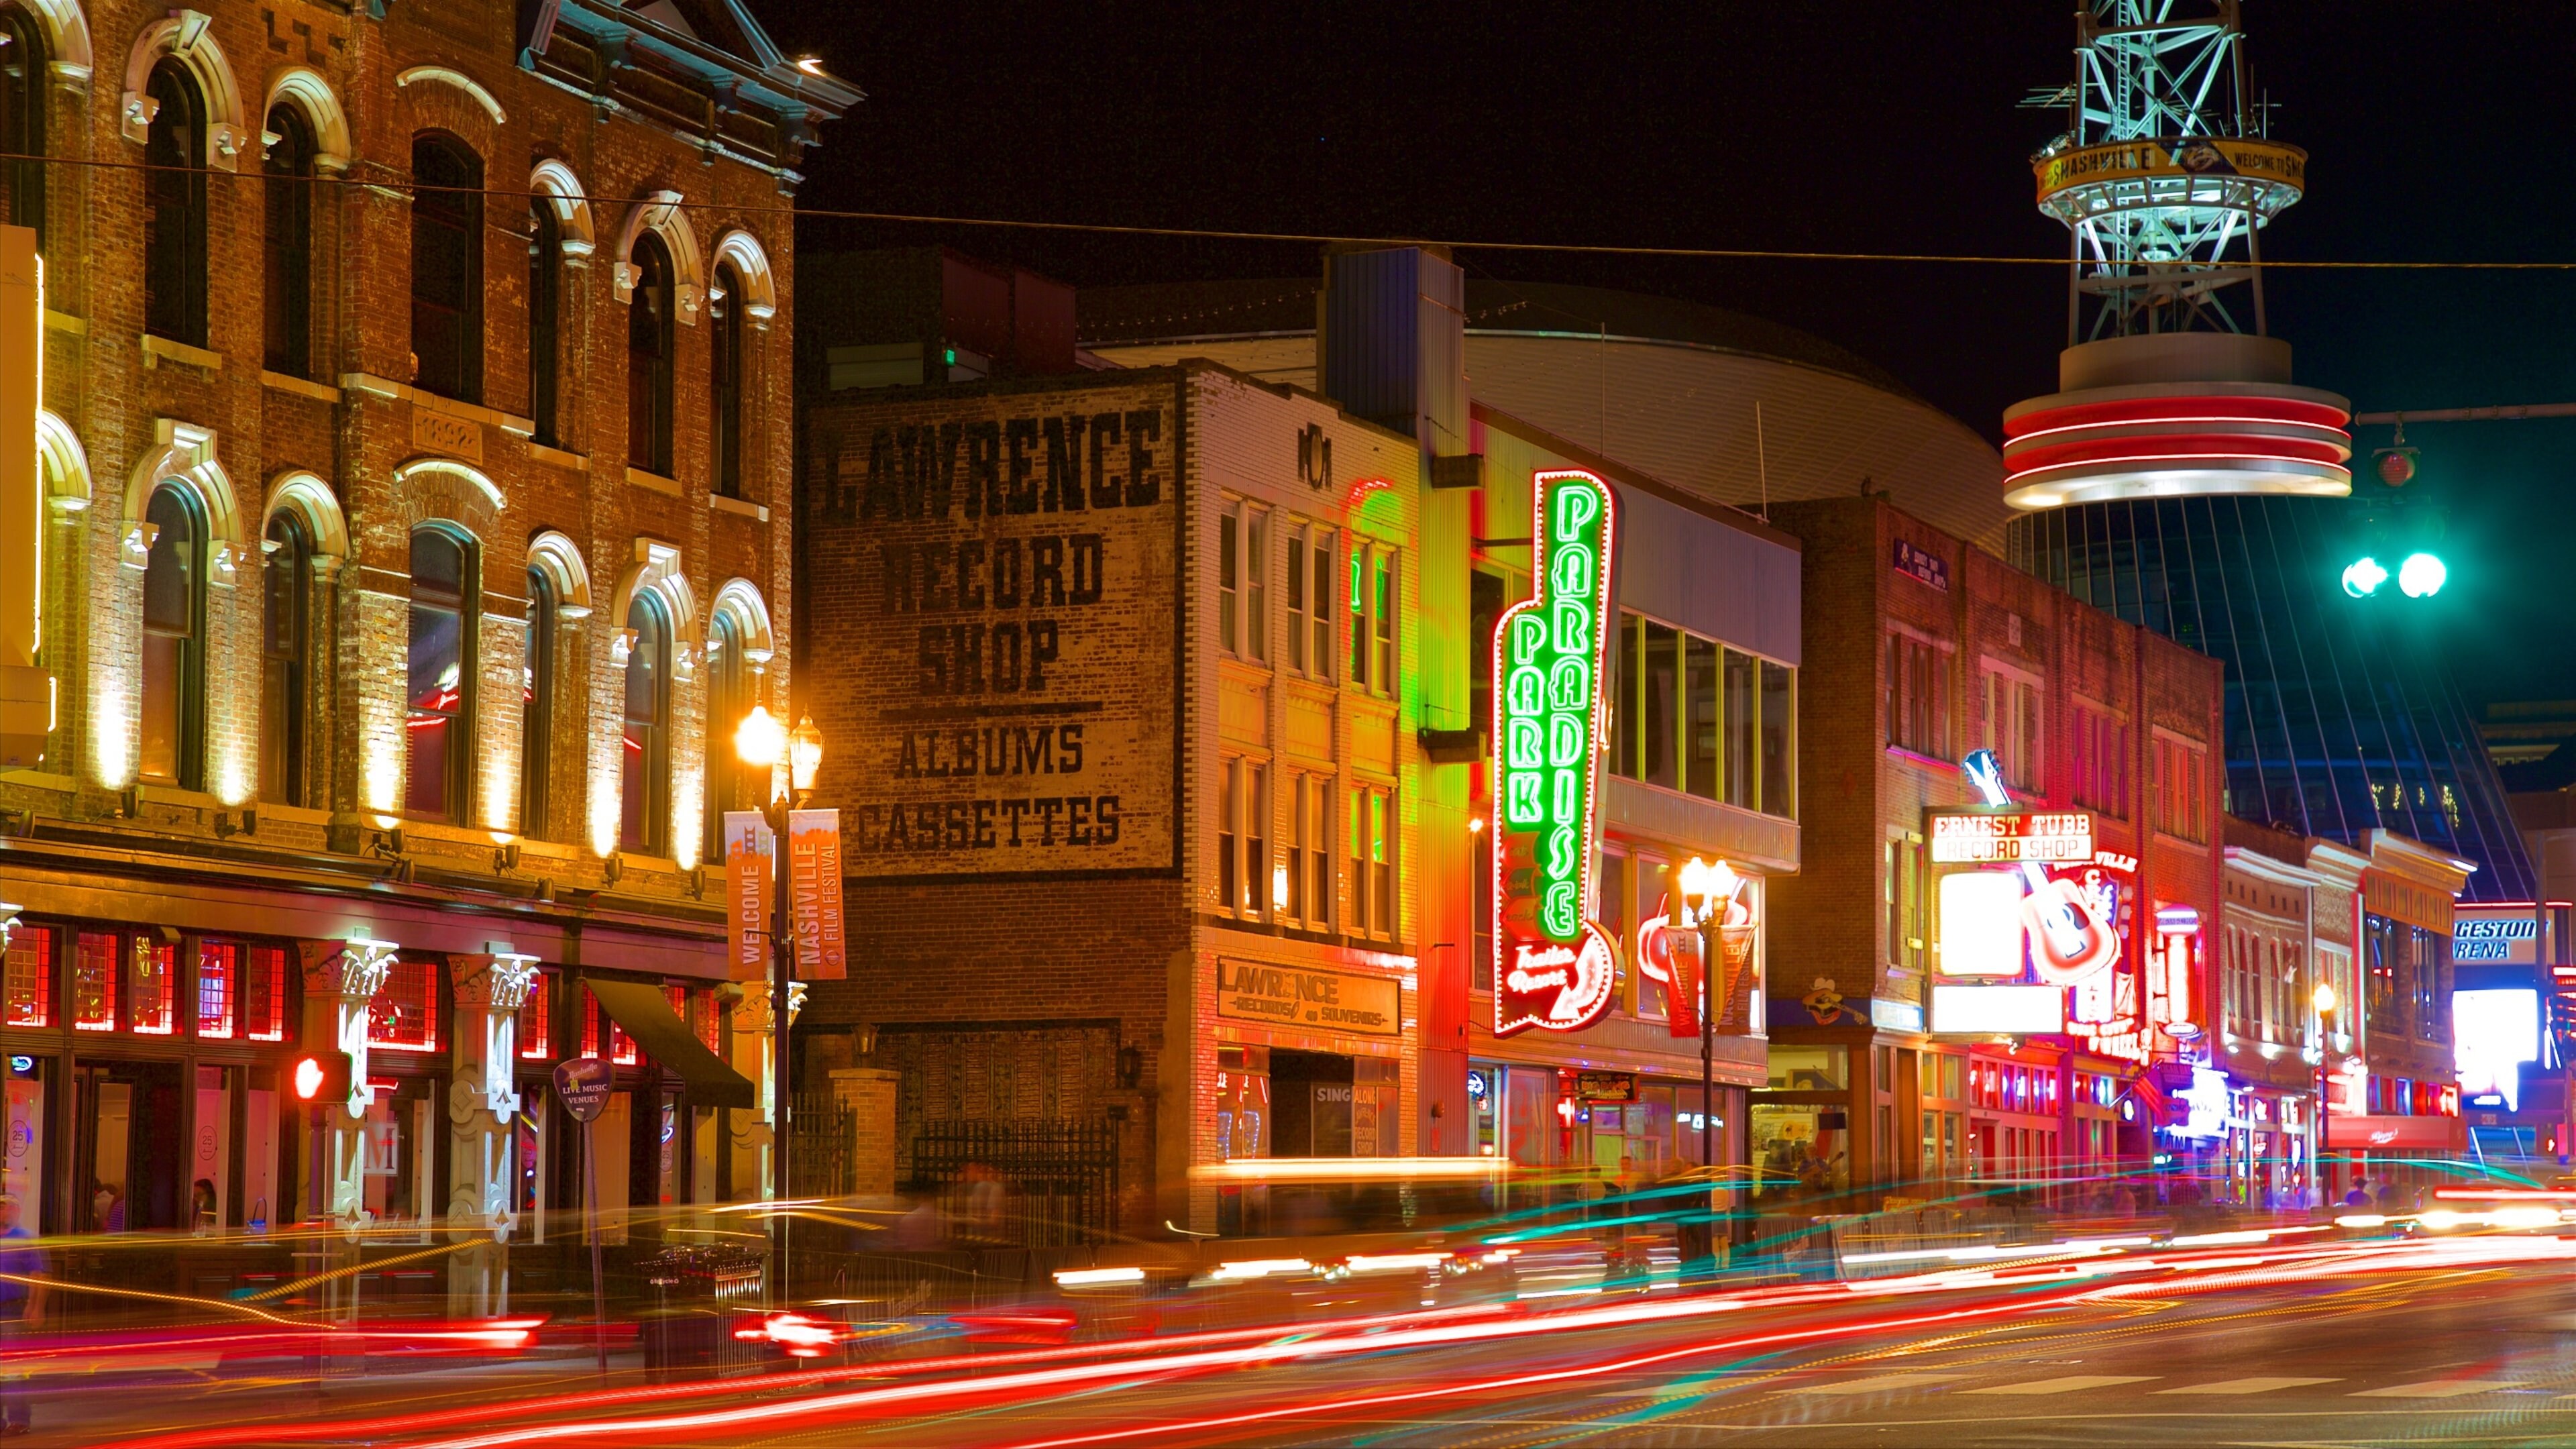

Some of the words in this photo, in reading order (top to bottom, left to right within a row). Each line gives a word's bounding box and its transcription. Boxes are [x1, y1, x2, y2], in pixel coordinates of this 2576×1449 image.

[2053, 148, 2150, 186] SMASHVILE
[2235, 152, 2275, 171] WELCOME
[422, 417, 470, 451] 1892
[821, 409, 1161, 525] LAWRENCE
[881, 534, 1103, 613] RECORD
[917, 620, 1059, 697] SHOP
[1508, 614, 1547, 823] PARK
[1544, 485, 1597, 936] PARADISE
[896, 724, 1083, 779] ALBUMS
[857, 796, 1120, 853] CASSETTES
[1934, 816, 2020, 838] ERNEST
[2031, 814, 2090, 836] TUBB
[1947, 840, 2020, 859] RECORD
[2029, 839, 2078, 857] SHOP
[820, 842, 838, 904] FESTIVAL
[741, 865, 760, 965] WELCOME
[794, 843, 822, 965] NASHVILLE
[823, 908, 839, 941] FILM
[2455, 919, 2551, 939] GESTON
[1515, 945, 1576, 969] Trailer
[1738, 953, 1750, 986] FESTIV
[1507, 969, 1567, 994] Resort
[1676, 961, 1690, 1026] WELCOME
[1236, 997, 1293, 1016] RECORDS
[1321, 1007, 1383, 1026] SOUVENIRS
[1737, 989, 1749, 1011] FILM
[569, 1063, 598, 1080] Nashville
[563, 1085, 581, 1095] LIVE
[582, 1083, 608, 1093] MUSIC
[568, 1095, 599, 1105] VENUES
[1317, 1088, 1351, 1102] SING
[1354, 1089, 1376, 1104] ALONG
[12, 1130, 23, 1141] 25
[203, 1135, 213, 1146] 25
